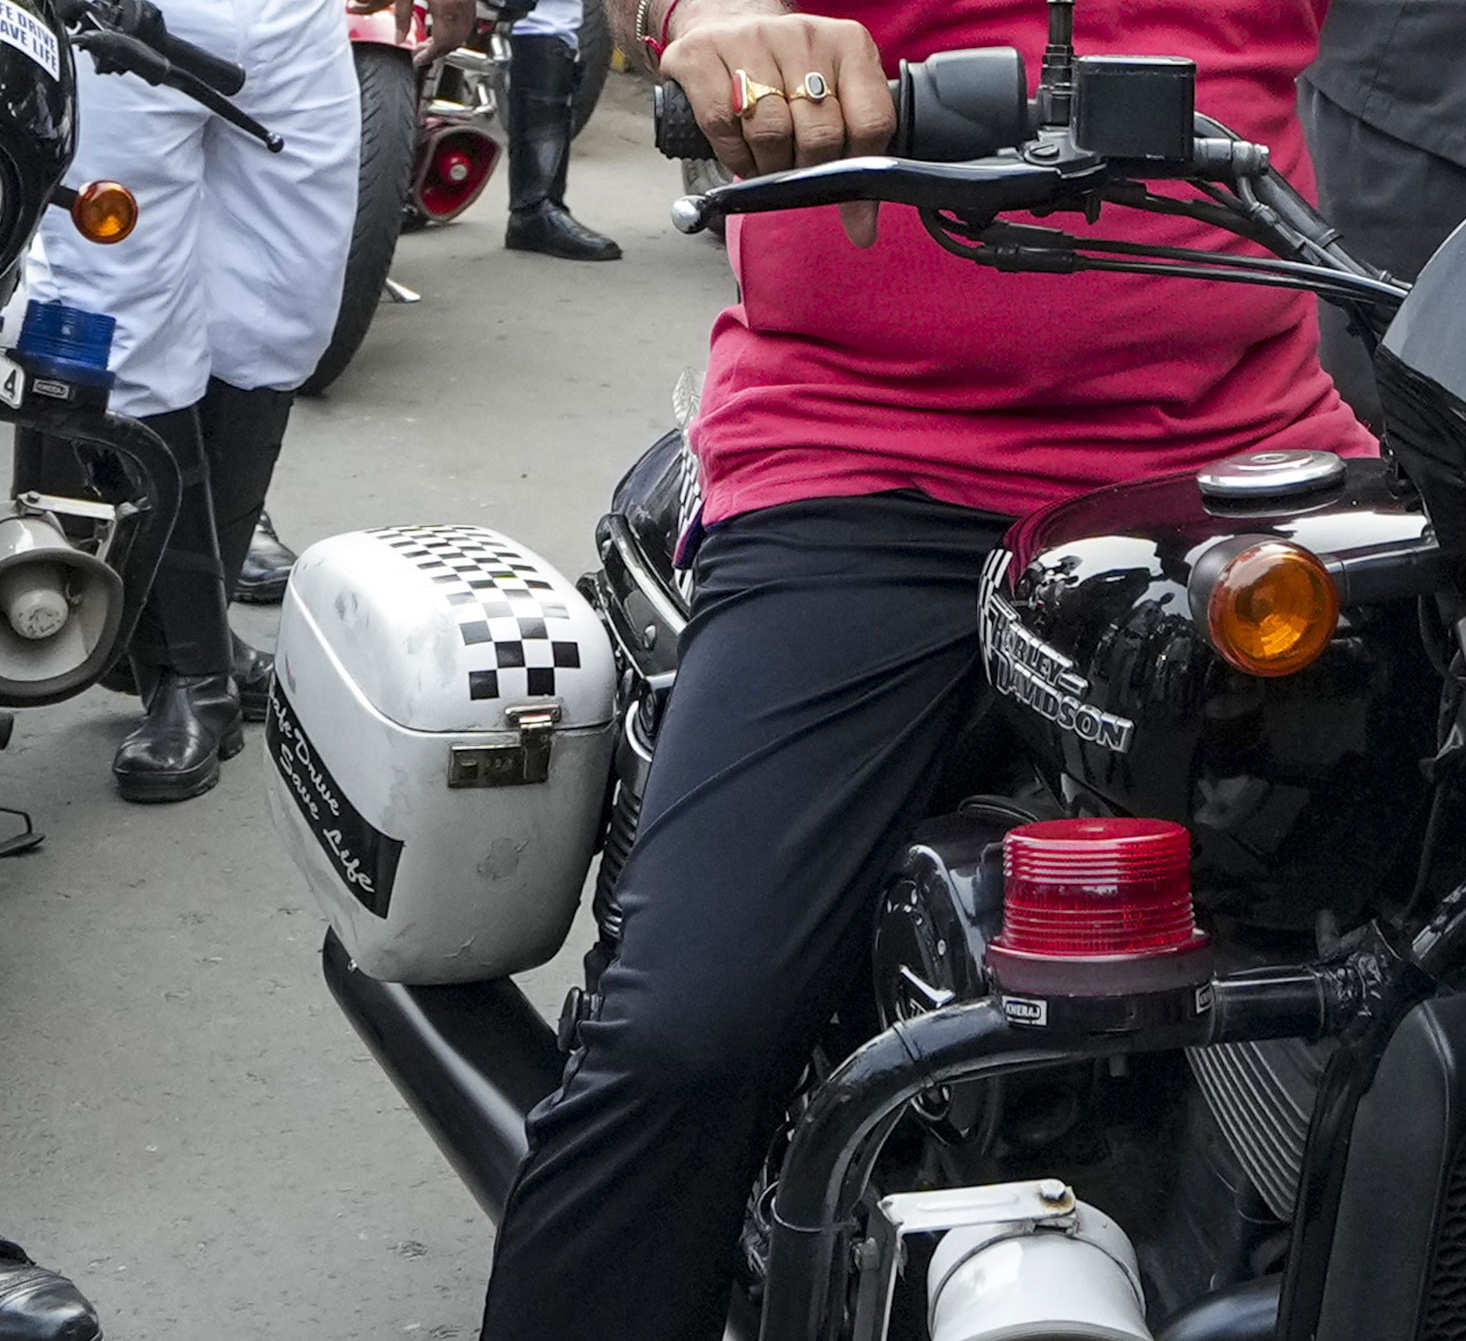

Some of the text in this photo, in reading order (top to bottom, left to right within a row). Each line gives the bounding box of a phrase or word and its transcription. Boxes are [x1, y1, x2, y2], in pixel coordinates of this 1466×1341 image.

[32, 36, 57, 73] LIFE
[994, 650, 1136, 755] DAVIDSON
[278, 742, 376, 894] Save Life
